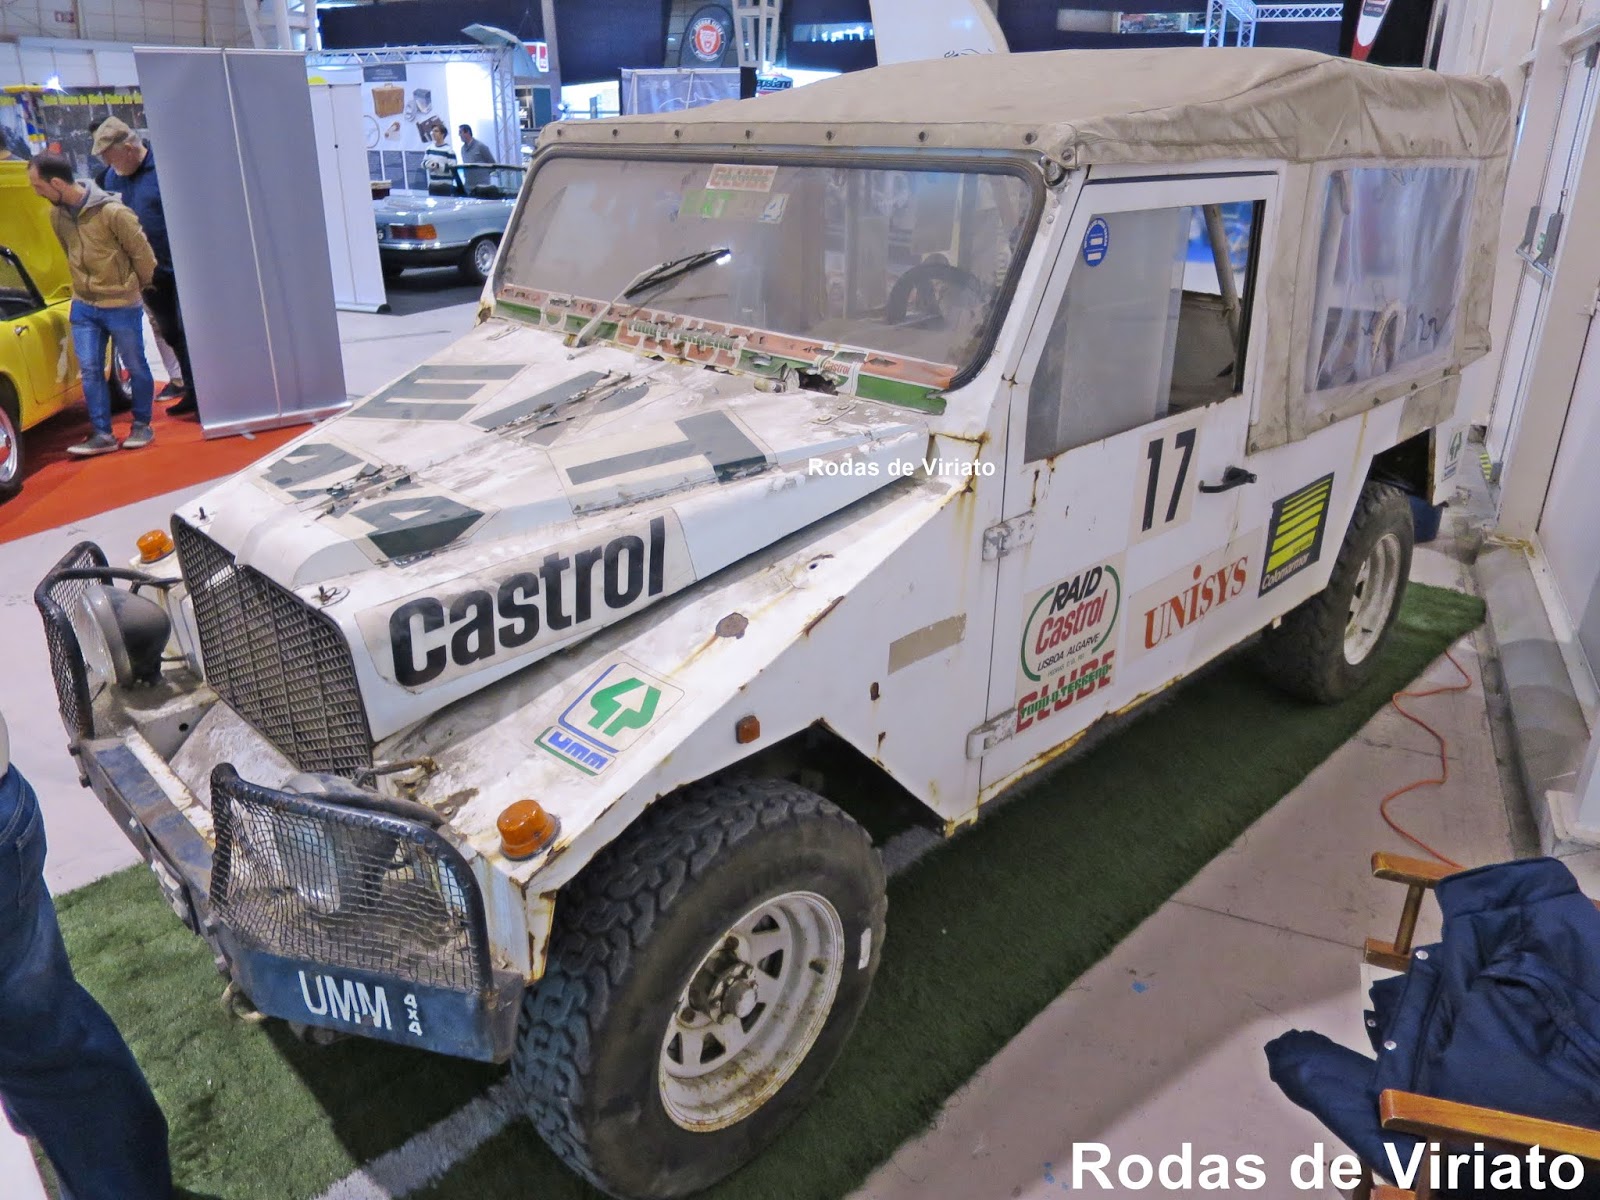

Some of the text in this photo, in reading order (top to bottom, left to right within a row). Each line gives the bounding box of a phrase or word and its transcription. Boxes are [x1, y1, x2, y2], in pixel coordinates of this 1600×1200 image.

[1142, 428, 1196, 532] 17
[389, 516, 665, 687] Castrol
[1035, 588, 1108, 655] Castrol
[1049, 566, 1102, 615] RAID
[1037, 632, 1100, 671] LISBOA ALGARVE
[298, 970, 392, 1030] UMM
